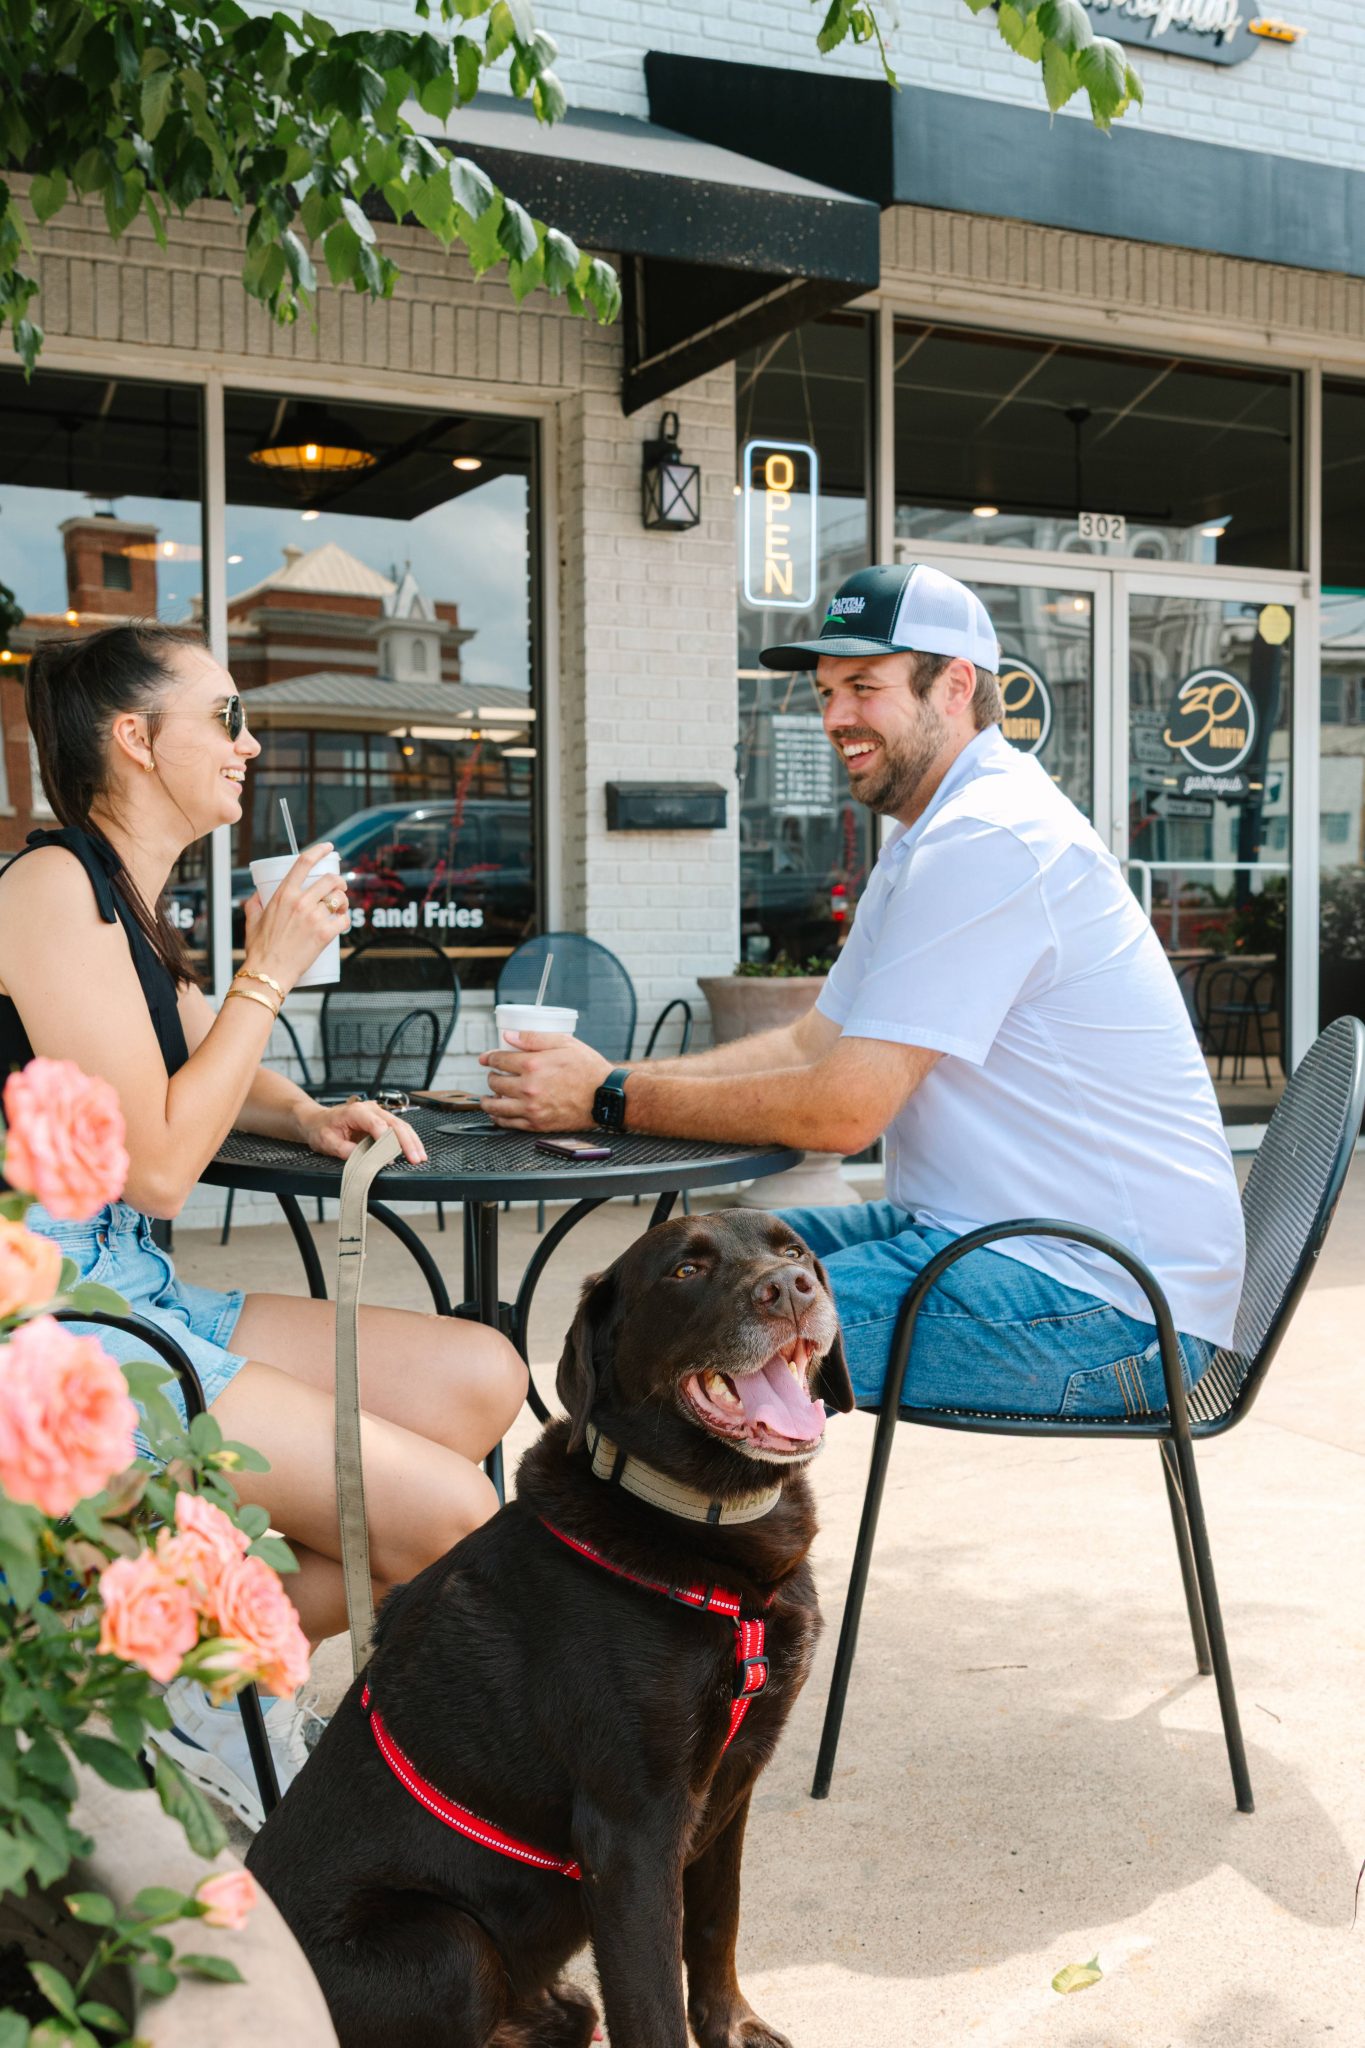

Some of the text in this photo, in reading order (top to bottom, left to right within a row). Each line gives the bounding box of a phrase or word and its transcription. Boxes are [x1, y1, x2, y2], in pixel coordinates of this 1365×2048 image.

[765, 454, 794, 596] OPEN
[1082, 515, 1121, 539] 302
[1163, 682, 1242, 748] 30
[1209, 727, 1246, 748] NORTH
[1182, 775, 1244, 796] gastropub
[372, 902, 417, 928] and
[424, 902, 484, 928] Fries
